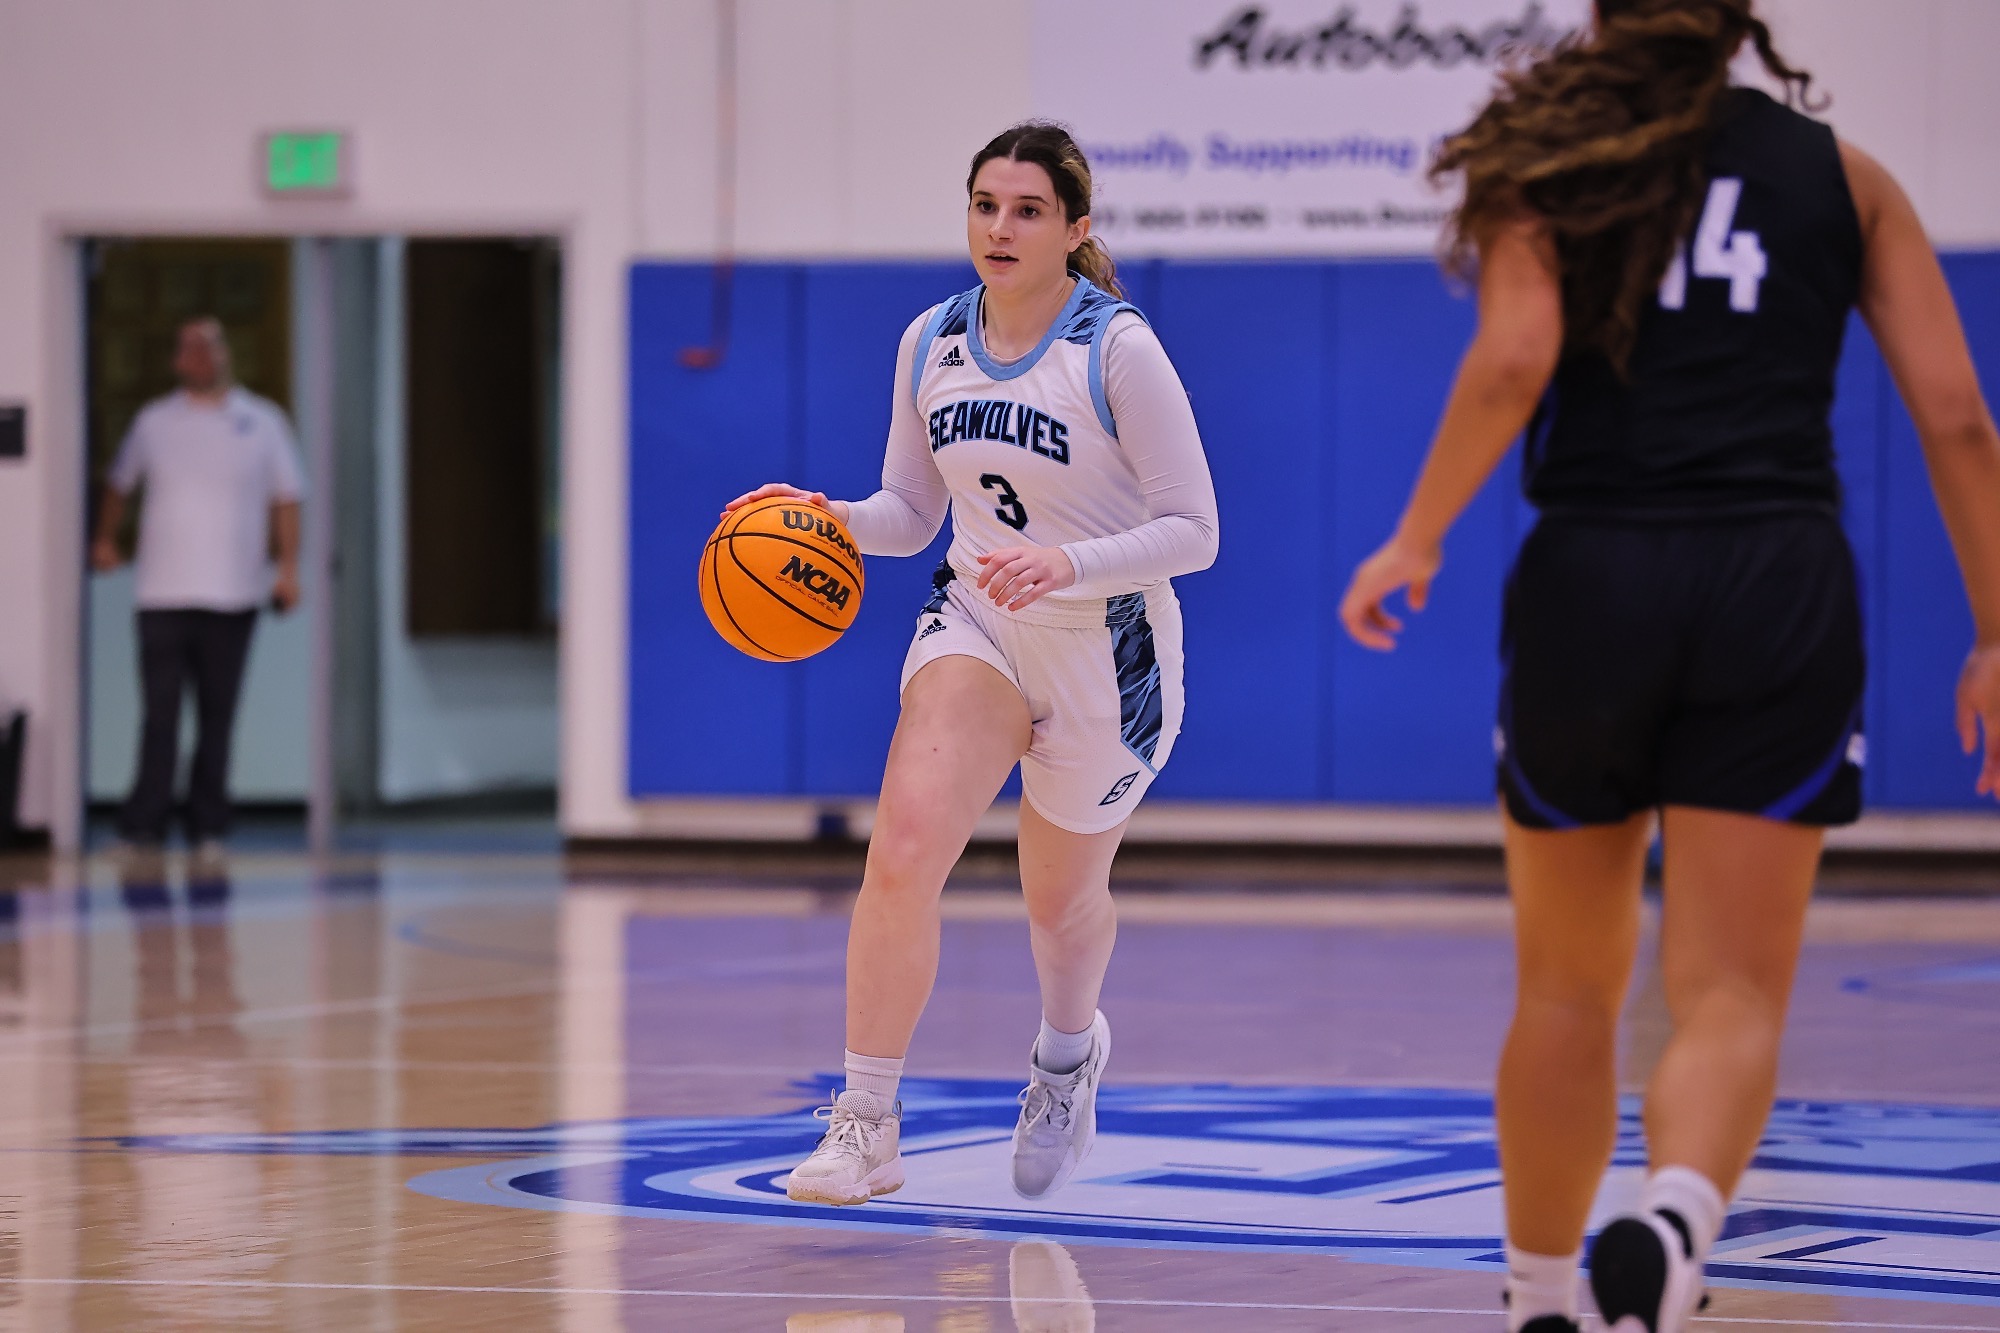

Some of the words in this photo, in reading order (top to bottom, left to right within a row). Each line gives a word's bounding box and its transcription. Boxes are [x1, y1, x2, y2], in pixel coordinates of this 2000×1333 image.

[1194, 0, 1567, 67] Autobod
[1207, 131, 1416, 175] Supporting
[938, 357, 965, 368] adidas
[929, 400, 1070, 466] SEAWOLVES
[979, 473, 1029, 532] 3
[780, 509, 863, 575] Wilson
[775, 575, 806, 596] OFFICIAL
[808, 593, 827, 608] GAME
[779, 554, 851, 612] NCAA
[918, 625, 948, 641] adidas
